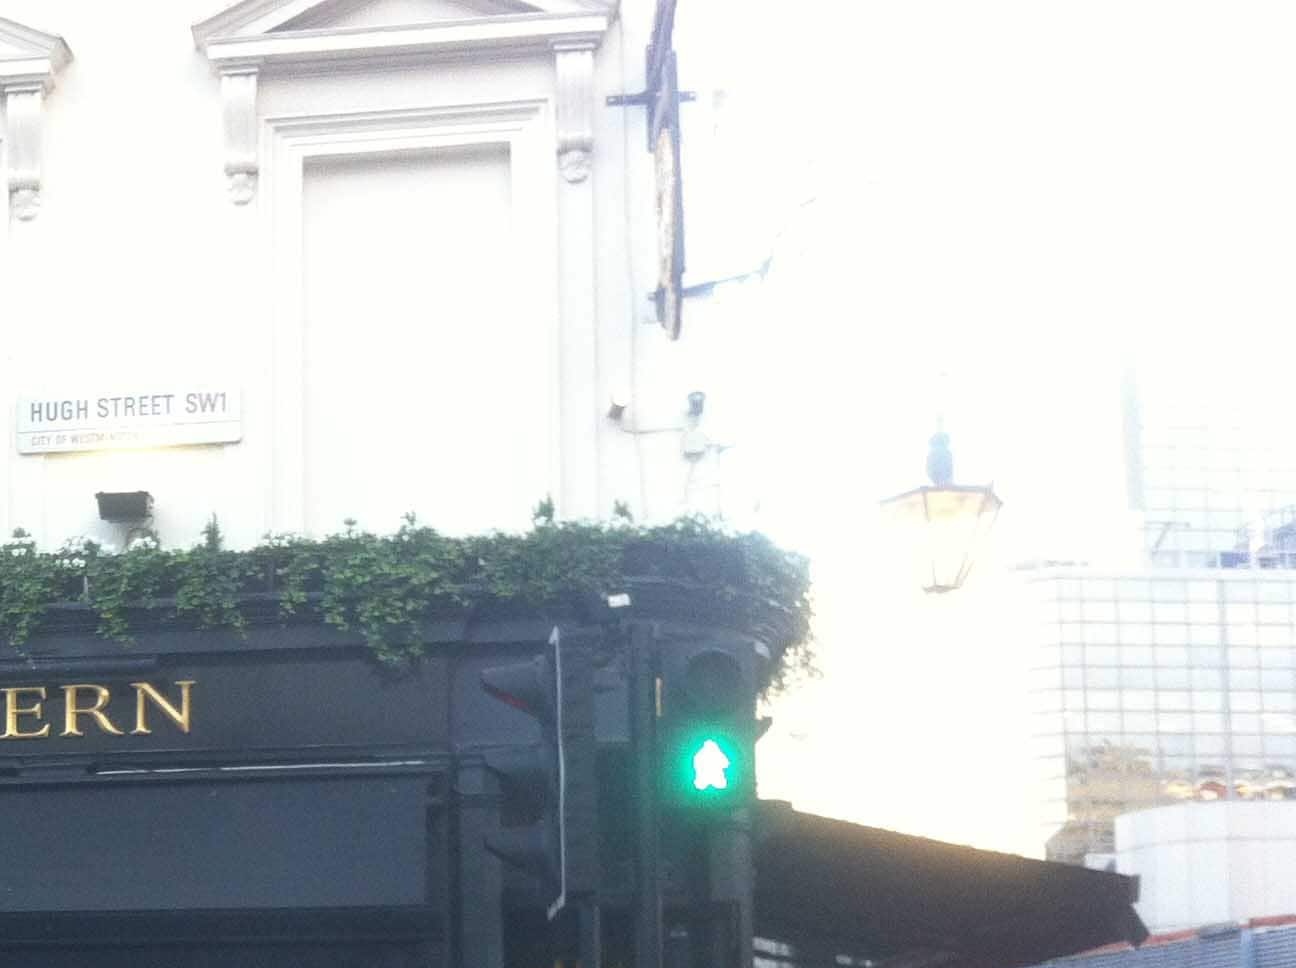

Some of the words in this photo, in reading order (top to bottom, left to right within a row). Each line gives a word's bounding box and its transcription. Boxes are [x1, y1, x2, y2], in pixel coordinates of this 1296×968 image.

[30, 400, 89, 422] HUGH
[97, 394, 175, 418] STREET
[185, 392, 228, 414] SW1
